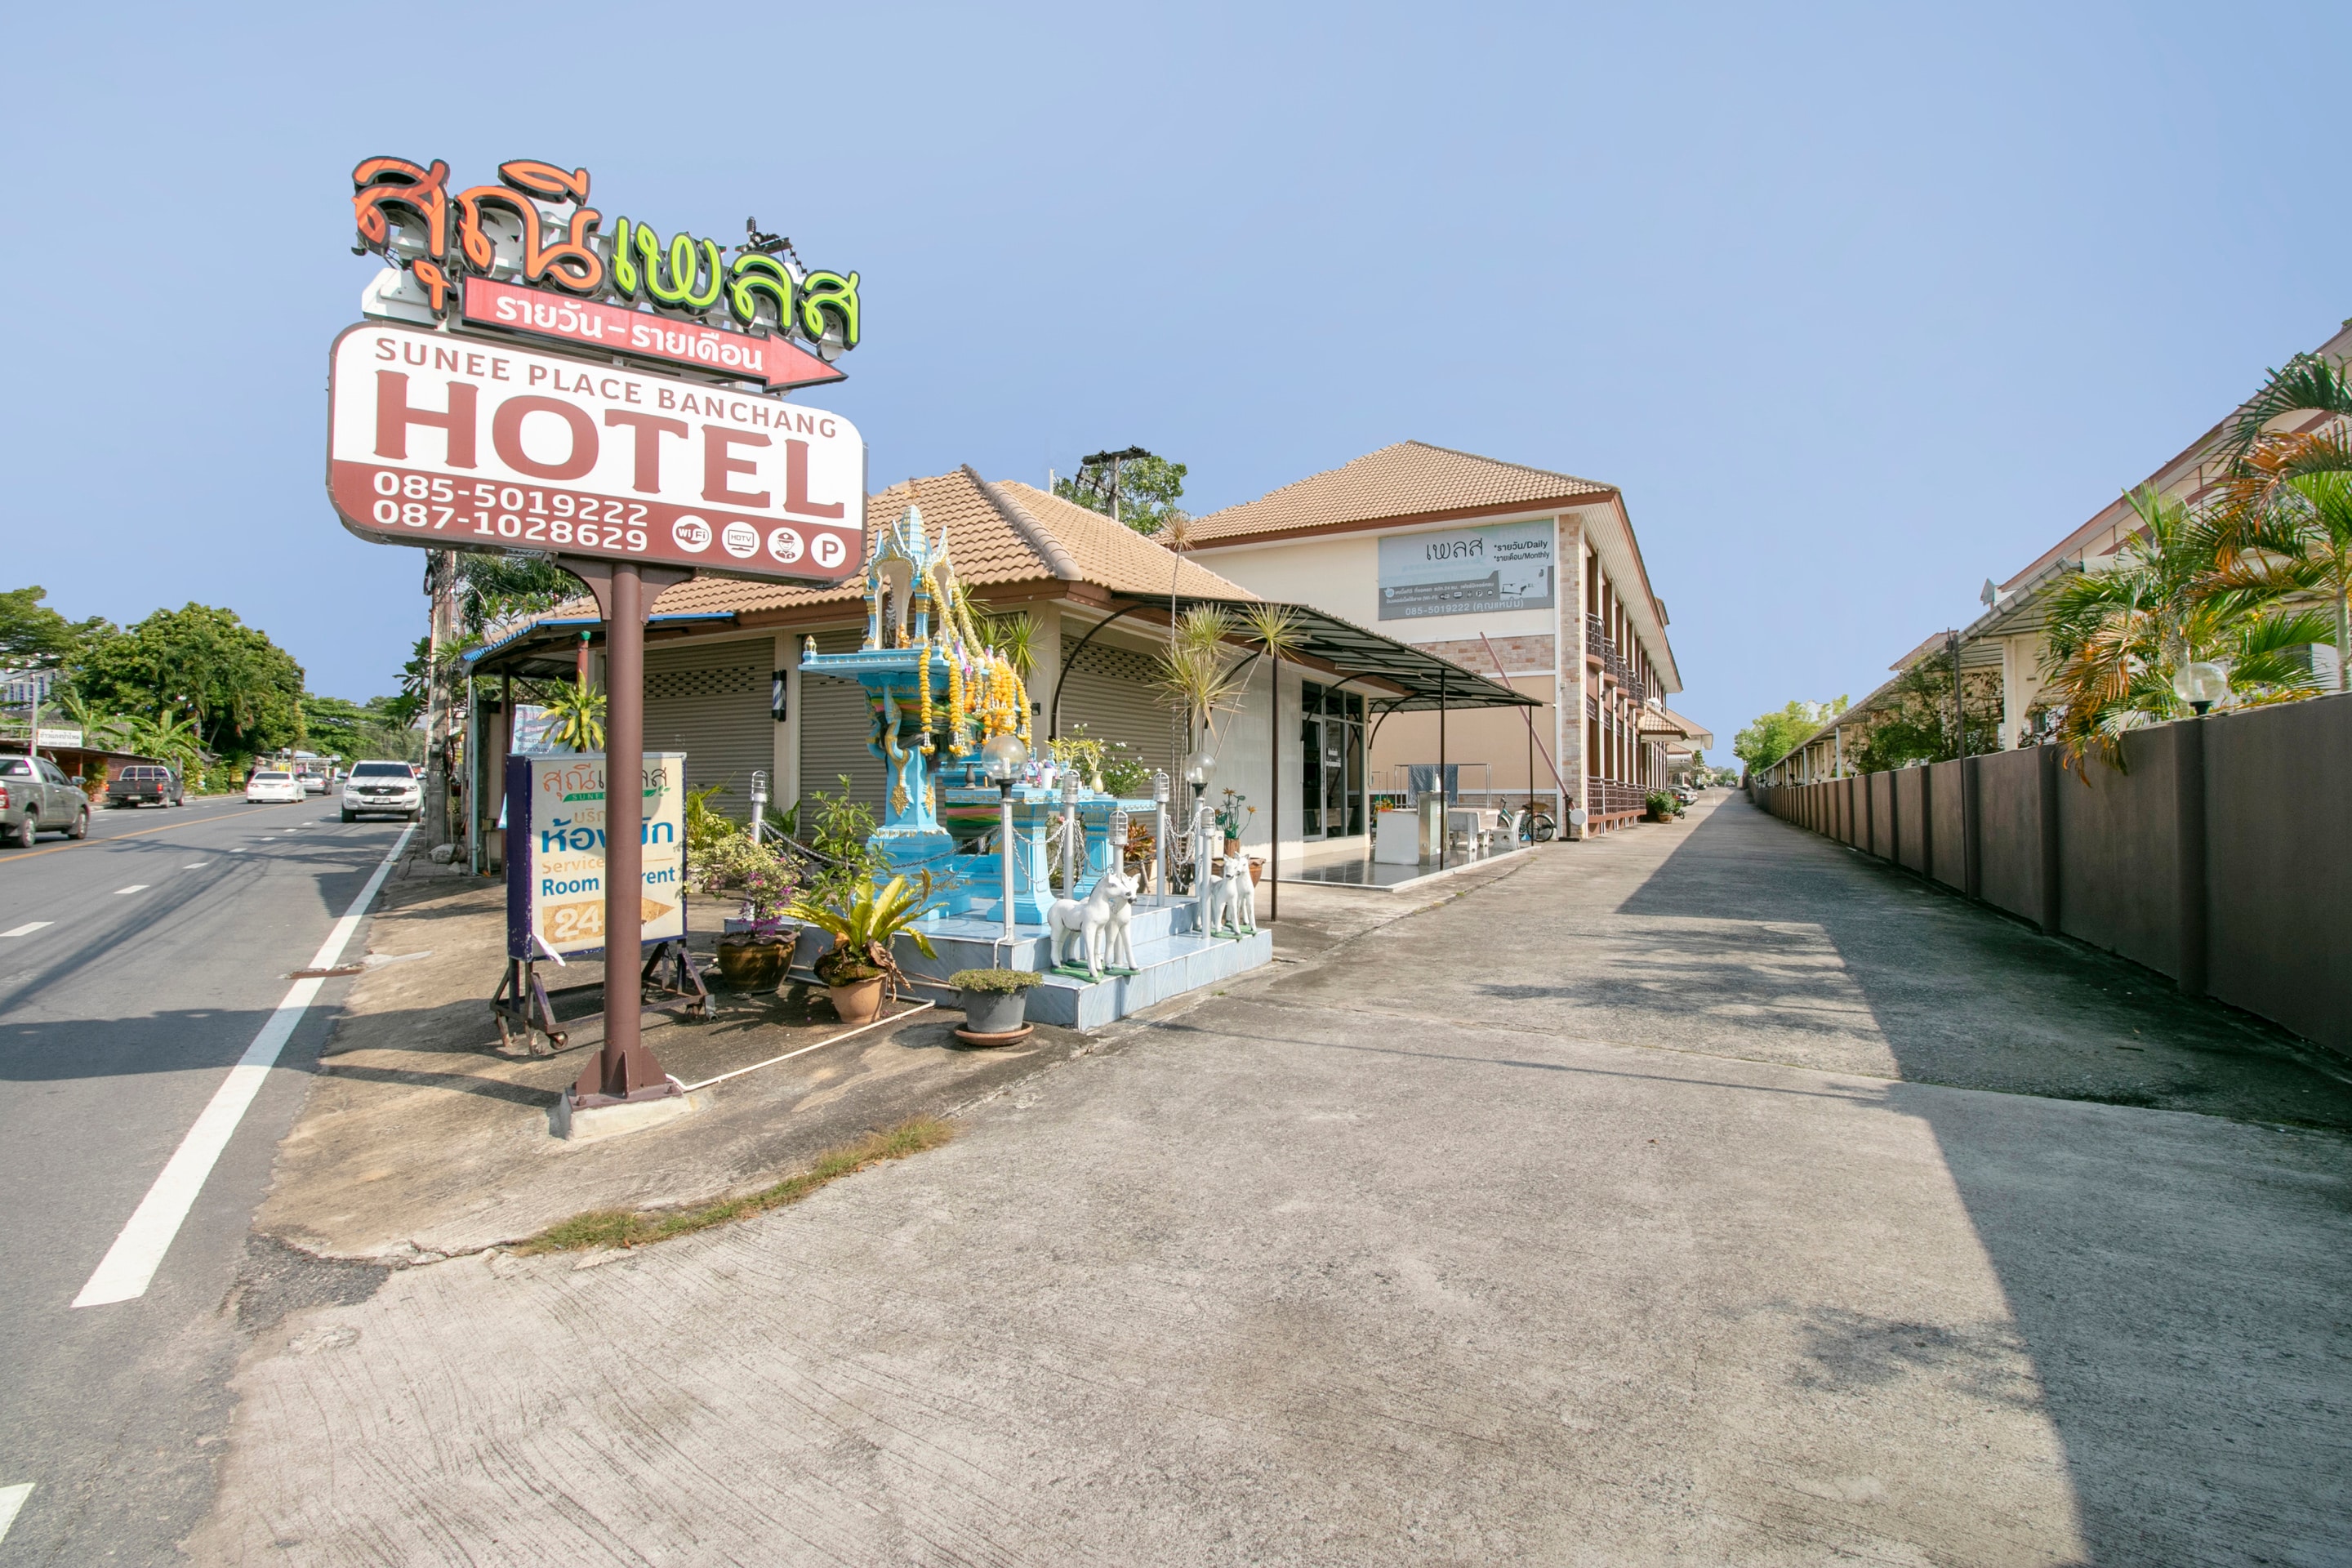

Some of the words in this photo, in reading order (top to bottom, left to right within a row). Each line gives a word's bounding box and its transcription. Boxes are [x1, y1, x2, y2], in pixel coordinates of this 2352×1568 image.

[375, 337, 510, 381] SUNEE
[528, 363, 642, 404] PLACE
[657, 387, 836, 439] BANCHANG
[372, 369, 844, 519] HOTEL
[373, 471, 648, 528] 085-5019222
[372, 499, 648, 552] 087-1028629
[730, 533, 752, 543] HDTV
[822, 539, 840, 562] P
[1426, 537, 1484, 561] เพลส
[1405, 603, 1471, 616] 085-5019222
[541, 856, 606, 875] Service
[541, 877, 599, 897] Room
[555, 904, 603, 939] 24
